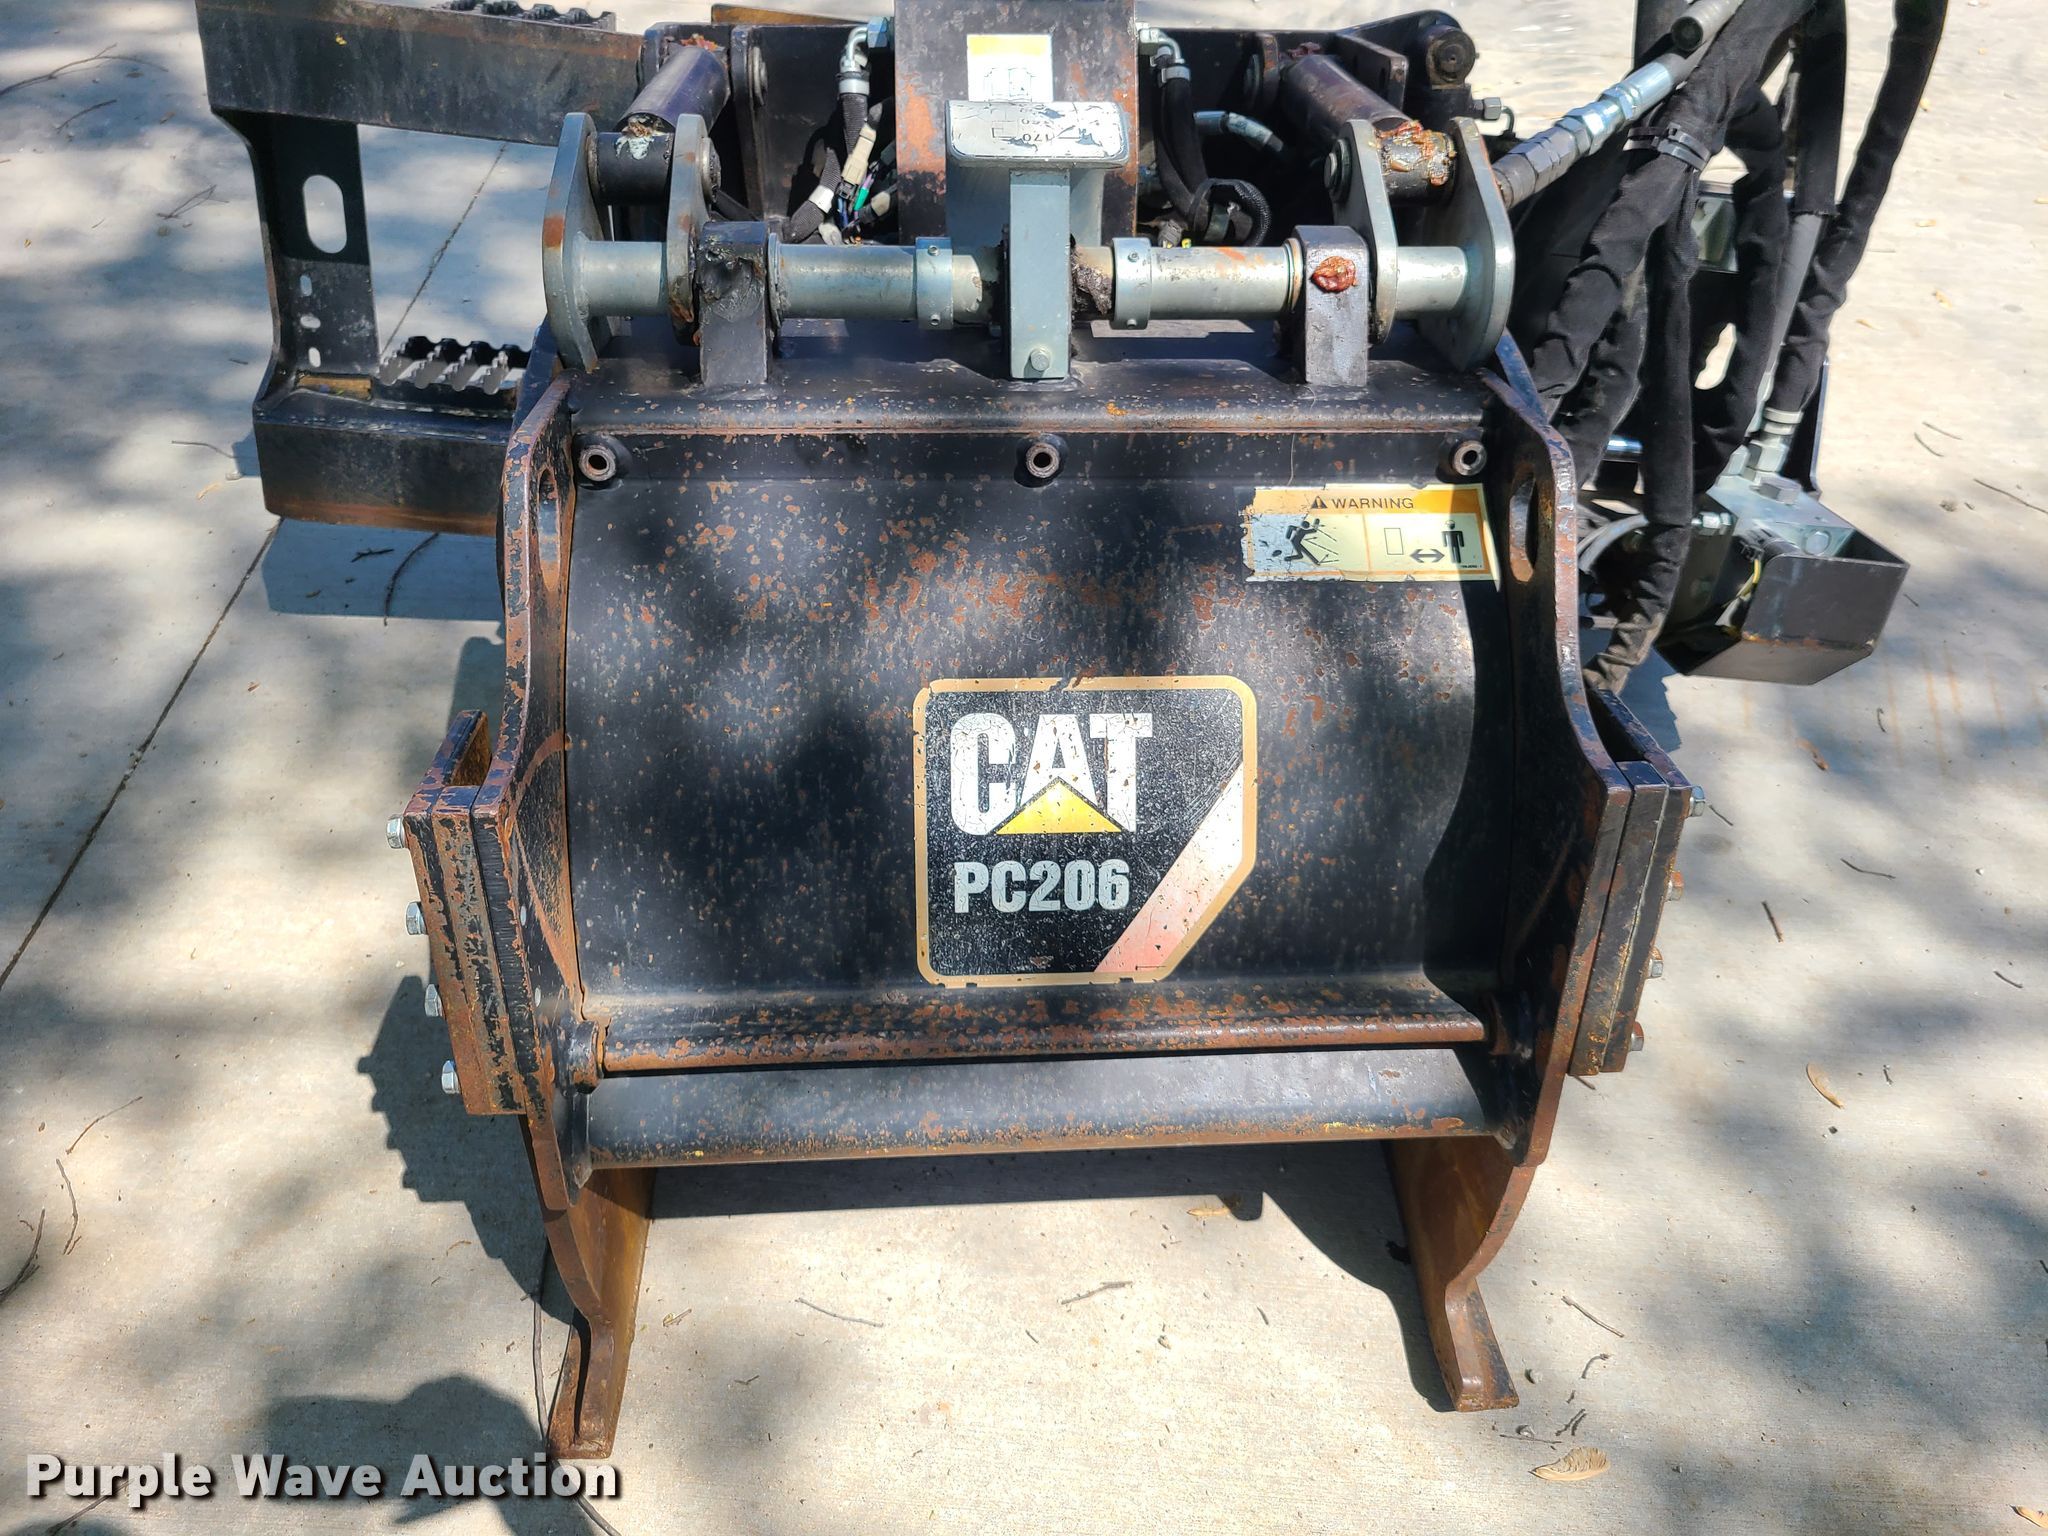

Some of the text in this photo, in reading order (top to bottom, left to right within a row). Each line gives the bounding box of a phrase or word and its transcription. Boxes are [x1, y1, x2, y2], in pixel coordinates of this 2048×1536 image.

[1331, 497, 1414, 509] WARNING
[949, 712, 1153, 836] CAT
[953, 859, 1130, 914] PC206
